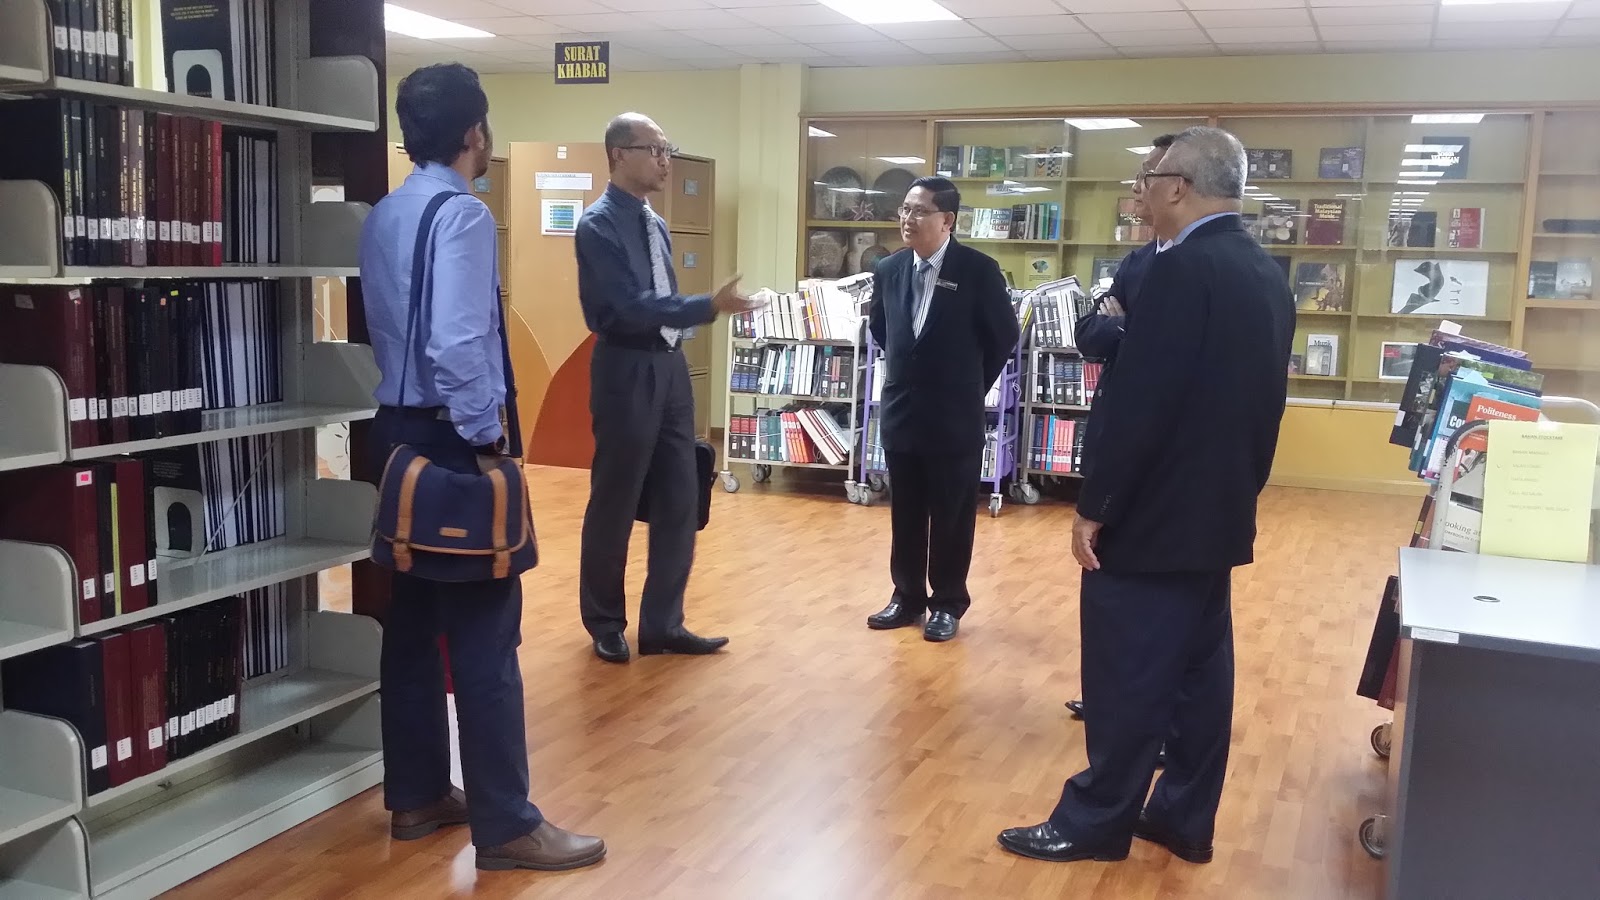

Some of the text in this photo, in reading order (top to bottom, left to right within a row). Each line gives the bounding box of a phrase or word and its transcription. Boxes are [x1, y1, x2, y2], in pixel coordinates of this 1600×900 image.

[564, 45, 601, 61] SURAT
[557, 62, 607, 78] KHABAR
[1476, 404, 1517, 421] Politeness
[1445, 521, 1472, 536] ooking
